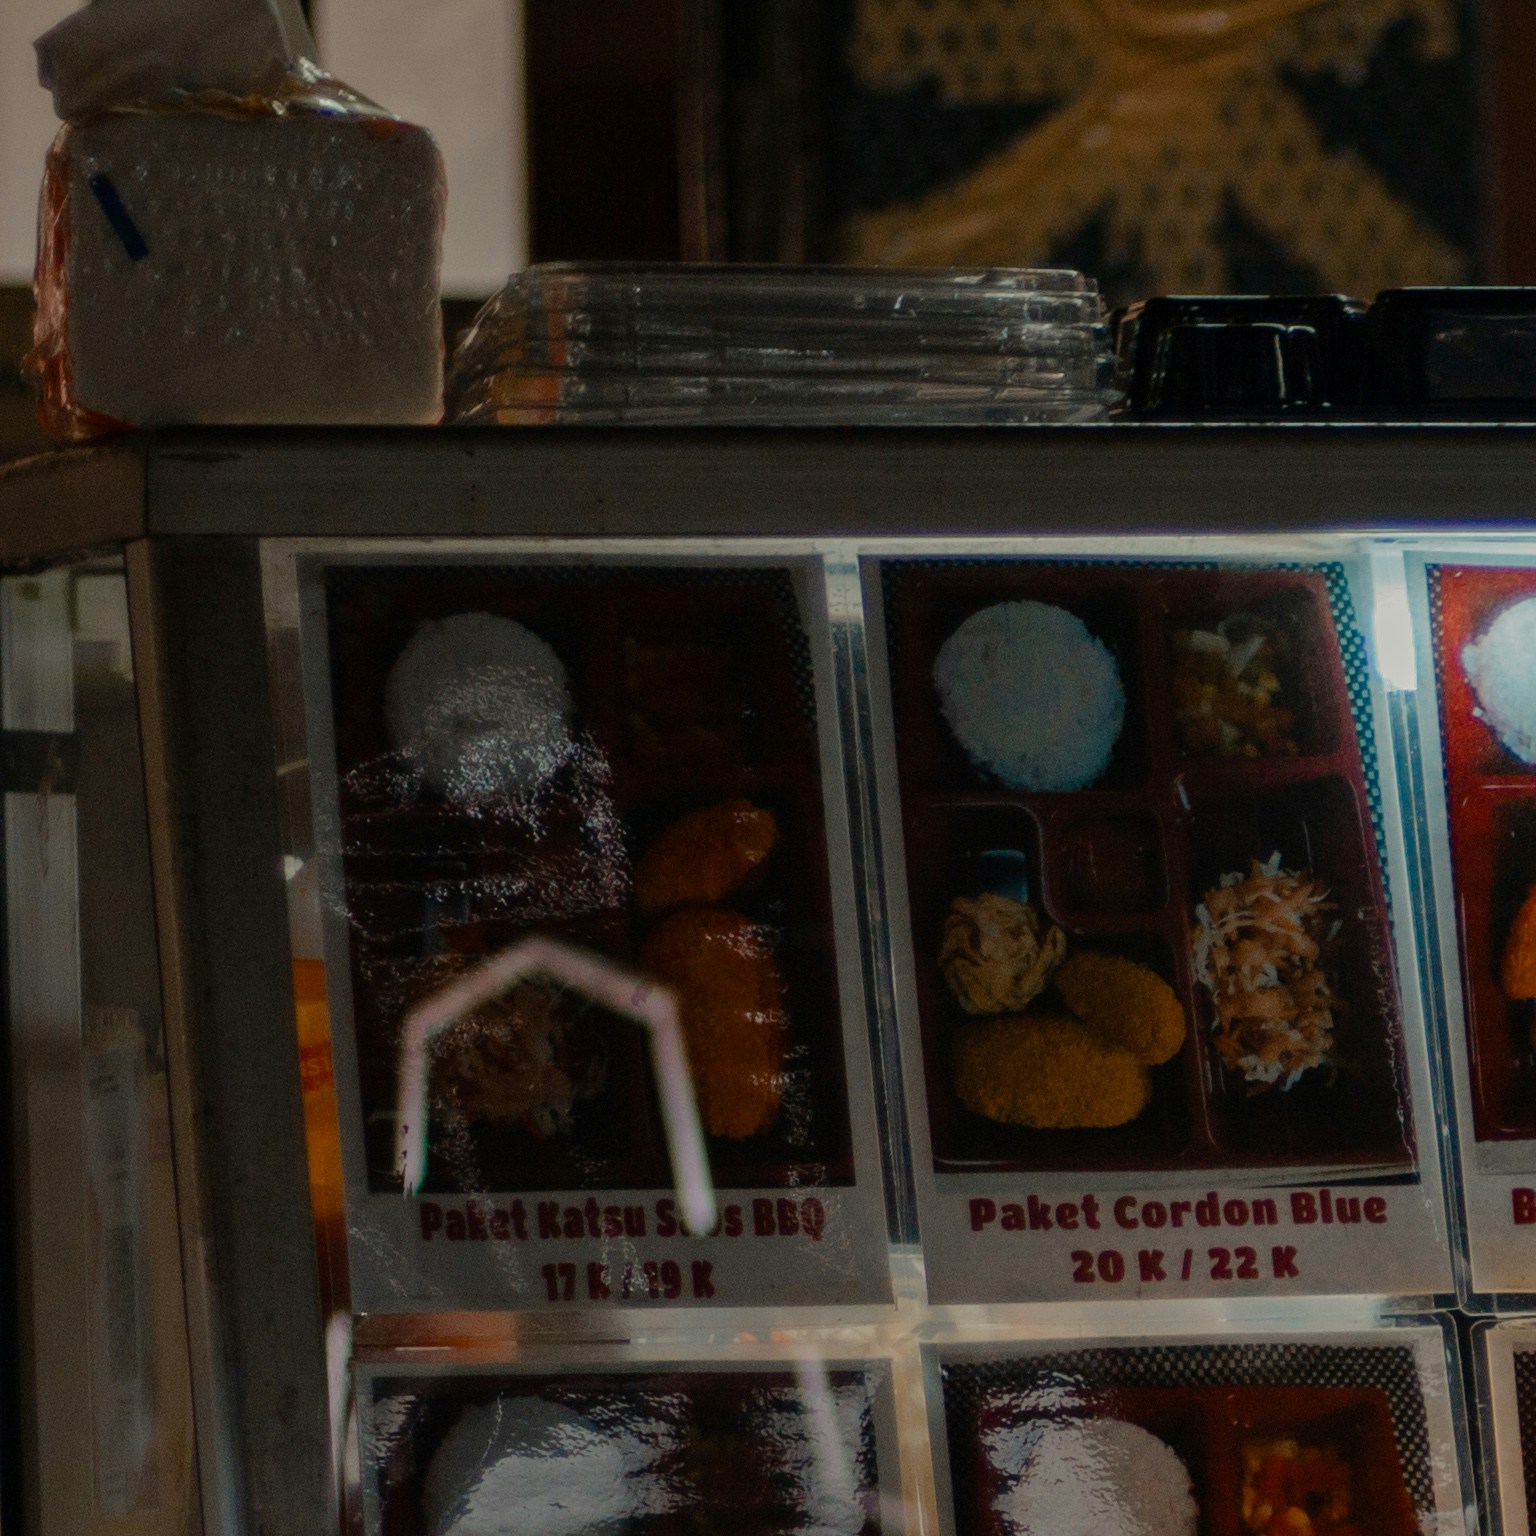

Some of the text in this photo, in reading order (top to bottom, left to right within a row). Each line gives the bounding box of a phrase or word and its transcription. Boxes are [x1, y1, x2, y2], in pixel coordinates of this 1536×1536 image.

[419, 1197, 824, 1242] Paket Katsu Ss BBQ
[968, 1188, 1389, 1232] Paket Cordon Blue
[541, 1262, 576, 1302] 17
[585, 1261, 612, 1301] K
[643, 1259, 682, 1300] 19
[691, 1260, 715, 1298] K
[1070, 1245, 1299, 1283] 20 K / 22 K
